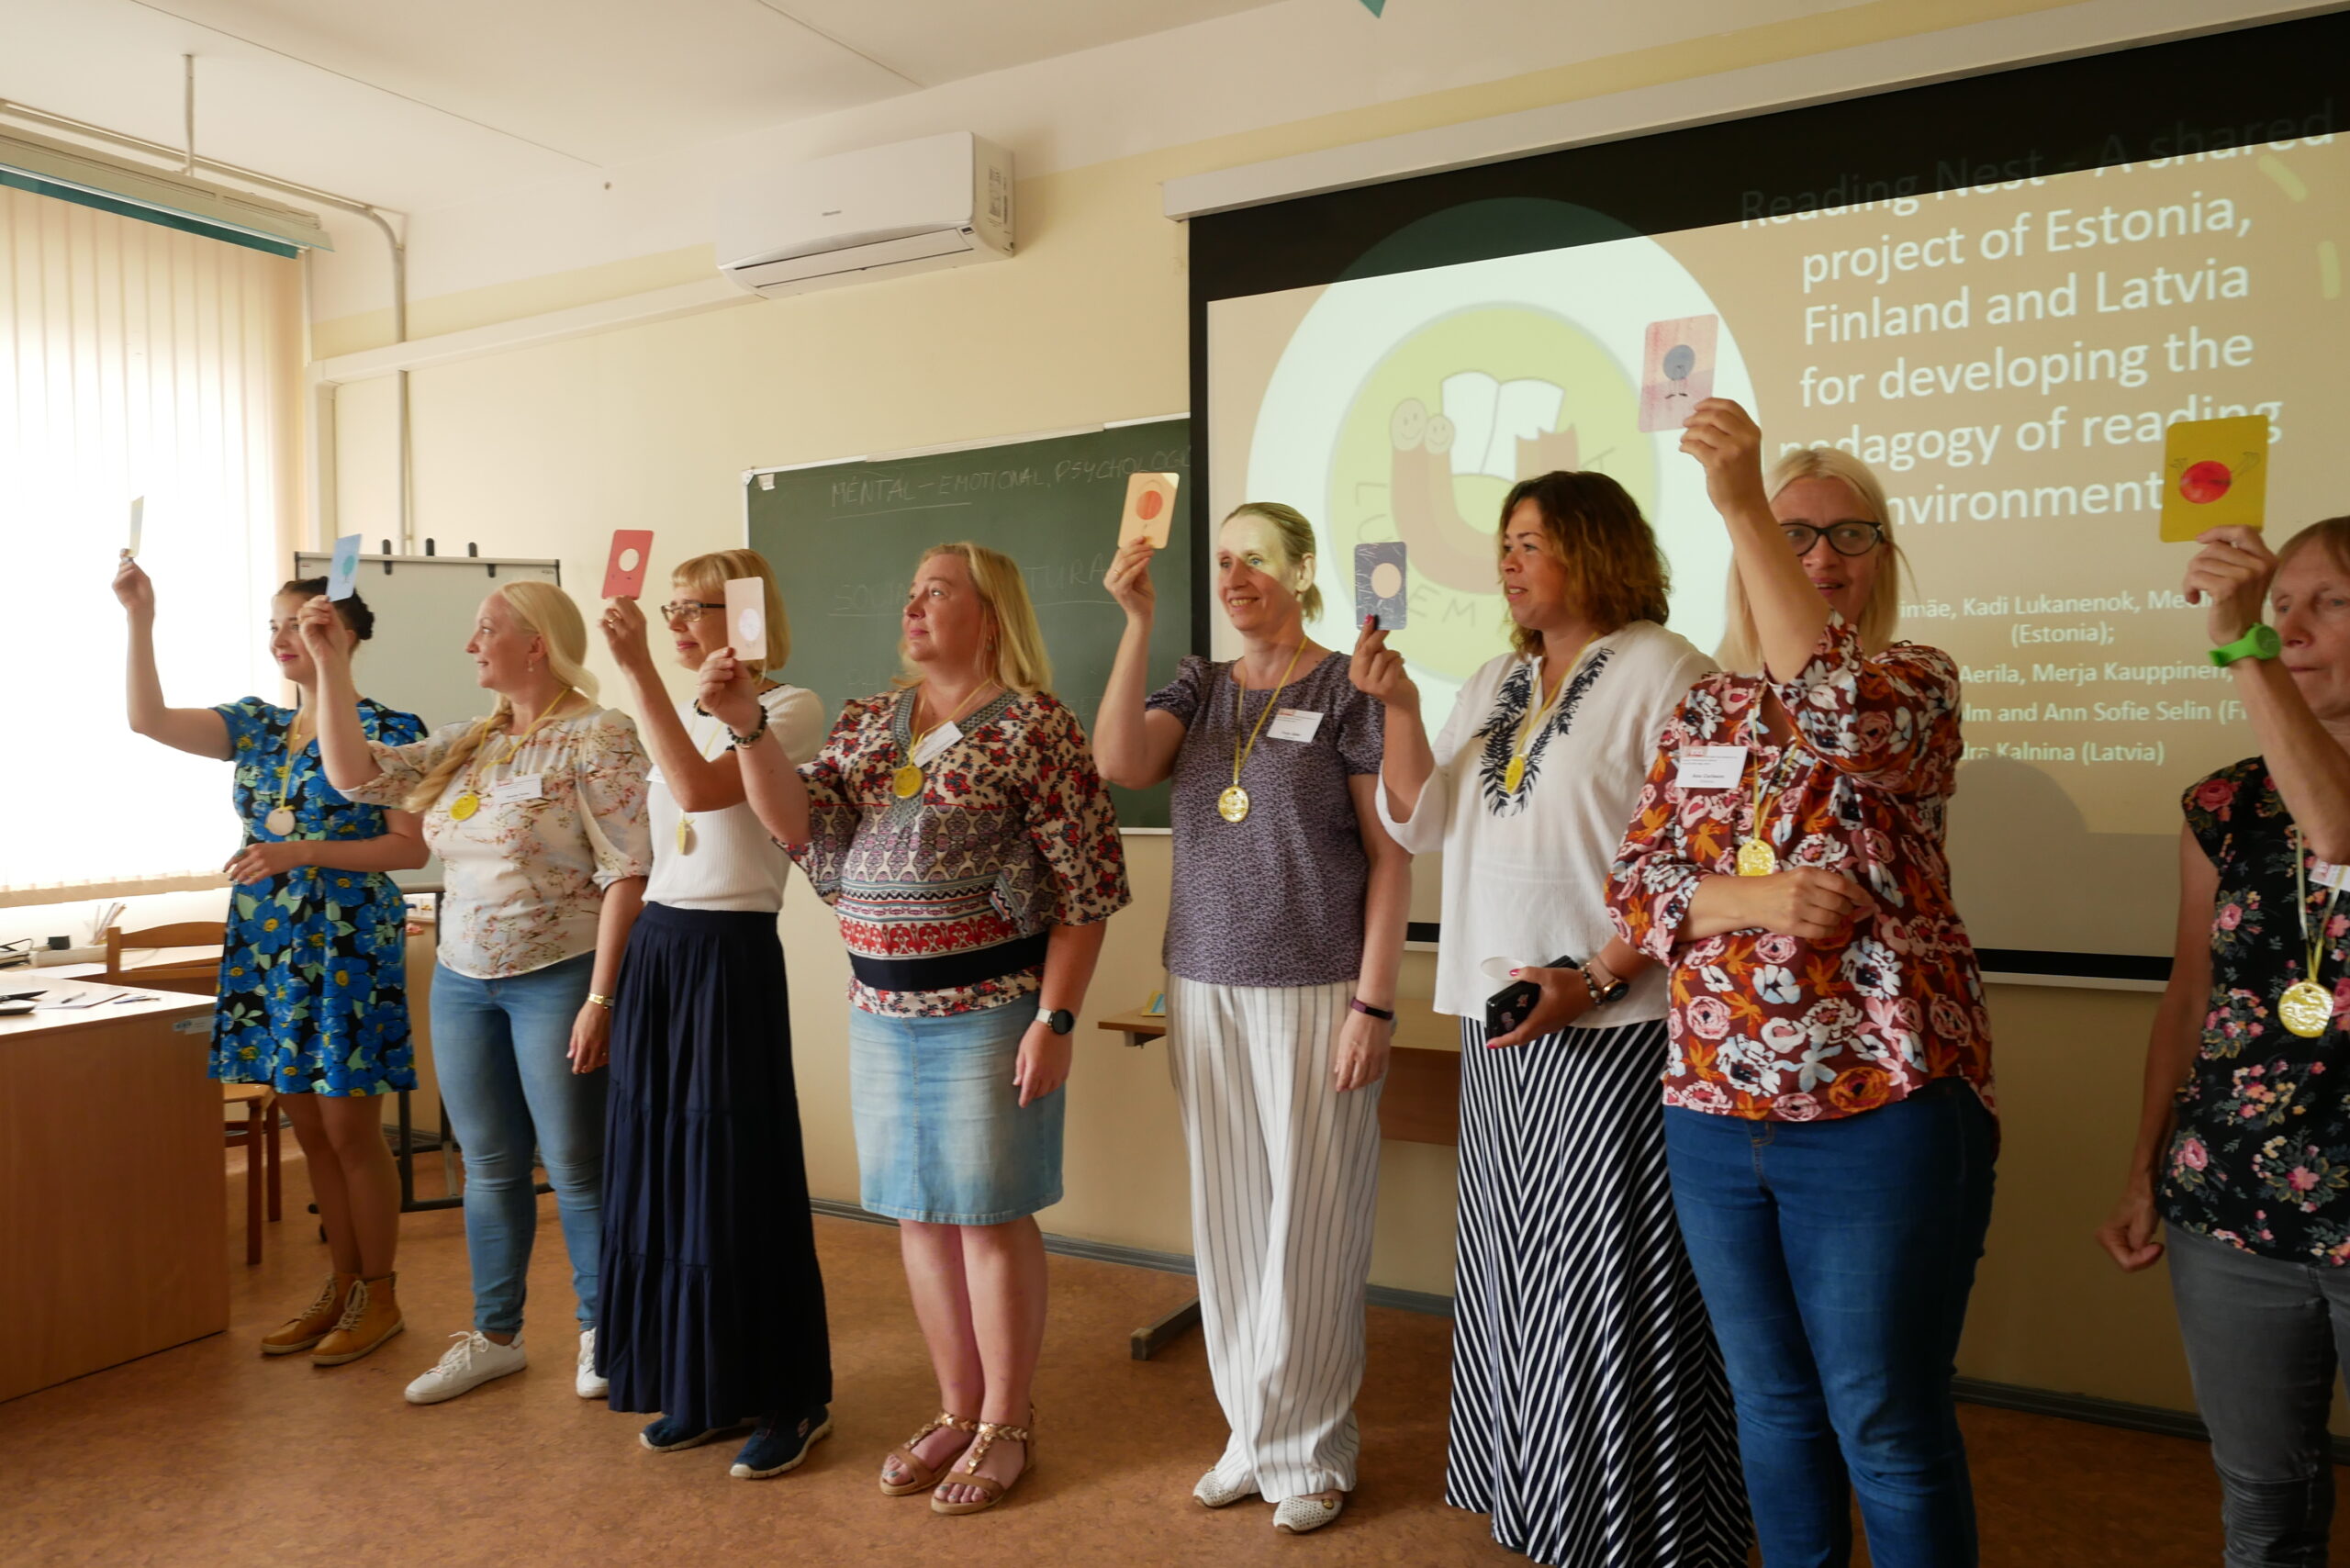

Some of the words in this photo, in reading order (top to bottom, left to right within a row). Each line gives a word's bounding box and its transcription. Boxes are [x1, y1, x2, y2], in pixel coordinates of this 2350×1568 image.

[1741, 174, 1919, 229] Reading
[1936, 149, 2046, 200] Nest
[2094, 134, 2132, 177] A
[2147, 97, 2335, 169] shared
[1803, 228, 1966, 293] project
[1980, 212, 2031, 262] of
[2046, 191, 2253, 252] Estonia,
[1804, 286, 1971, 345] Finland
[1986, 273, 2077, 325] and
[2097, 258, 2249, 313] Latvia
[1799, 366, 1865, 408] for
[1878, 341, 2149, 395] developing
[2163, 326, 2254, 374] the
[1779, 423, 2002, 472] dagogy
[2016, 407, 2068, 453] of
[1887, 471, 2165, 527] nvironment
[1963, 596, 2009, 616] Kadi
[2014, 591, 2141, 615] Lukanenok,
[2010, 620, 2115, 648] (Estonia);
[1959, 663, 2026, 686] Aerila,
[2032, 662, 2098, 687] Merja
[2103, 658, 2233, 685] Kauppinen,
[1962, 702, 1992, 722] lm
[1997, 702, 2039, 722] and
[2042, 701, 2088, 722] Ann
[2093, 700, 2151, 722] Sofie
[2155, 699, 2211, 721] Selin
[1997, 741, 2076, 762] Kalnina
[2081, 741, 2165, 766] (Latvia)
